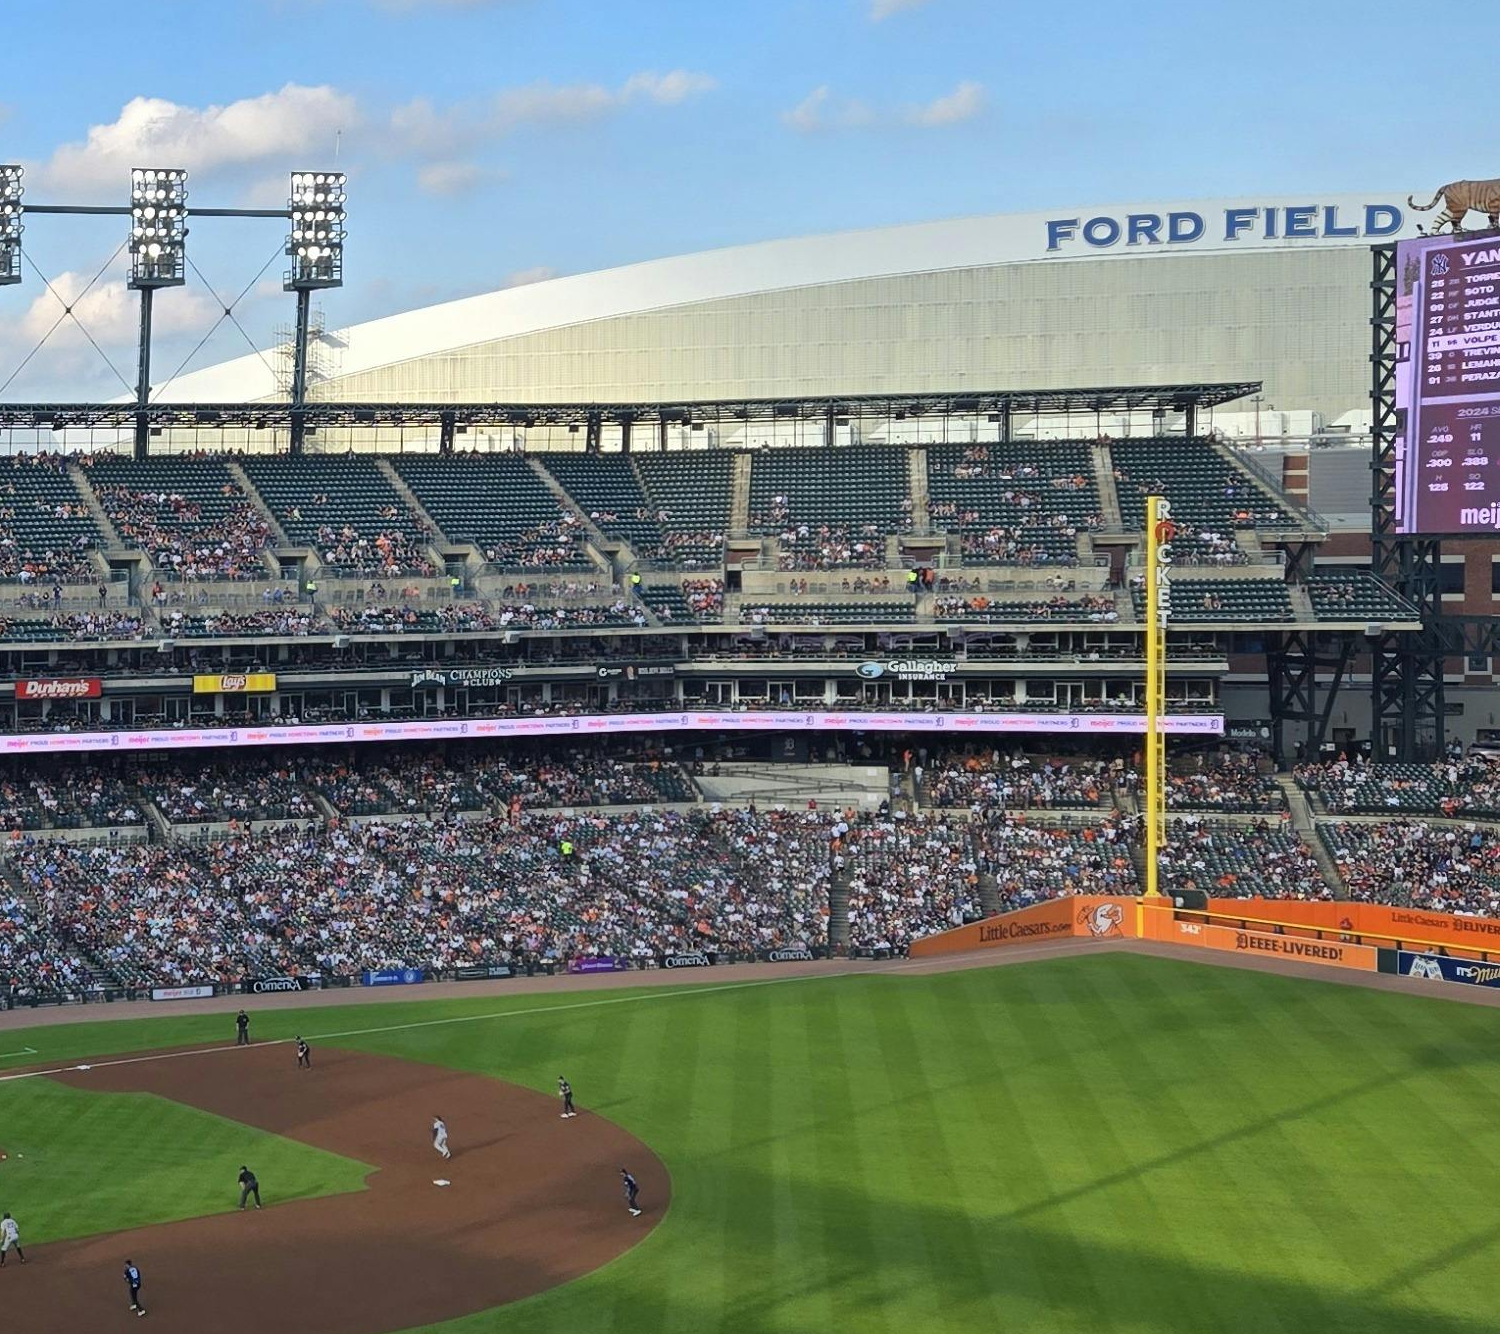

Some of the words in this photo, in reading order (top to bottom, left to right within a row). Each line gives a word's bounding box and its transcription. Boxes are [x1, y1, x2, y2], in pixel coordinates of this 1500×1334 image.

[1046, 211, 1206, 252] FORD
[1222, 204, 1404, 241] FIELD
[1464, 285, 1495, 301] SOTO
[1464, 297, 1499, 307] JUDGE
[1429, 315, 1444, 324] 27
[1428, 327, 1444, 337] 24
[1464, 335, 1498, 344] VOLPE
[1457, 407, 1489, 417] 2024
[1470, 433, 1482, 441] 11
[887, 661, 957, 674] Gallagher
[449, 669, 513, 680] CHAMPIONS
[898, 673, 946, 681] INSURANCE
[470, 679, 495, 687] CLUB
